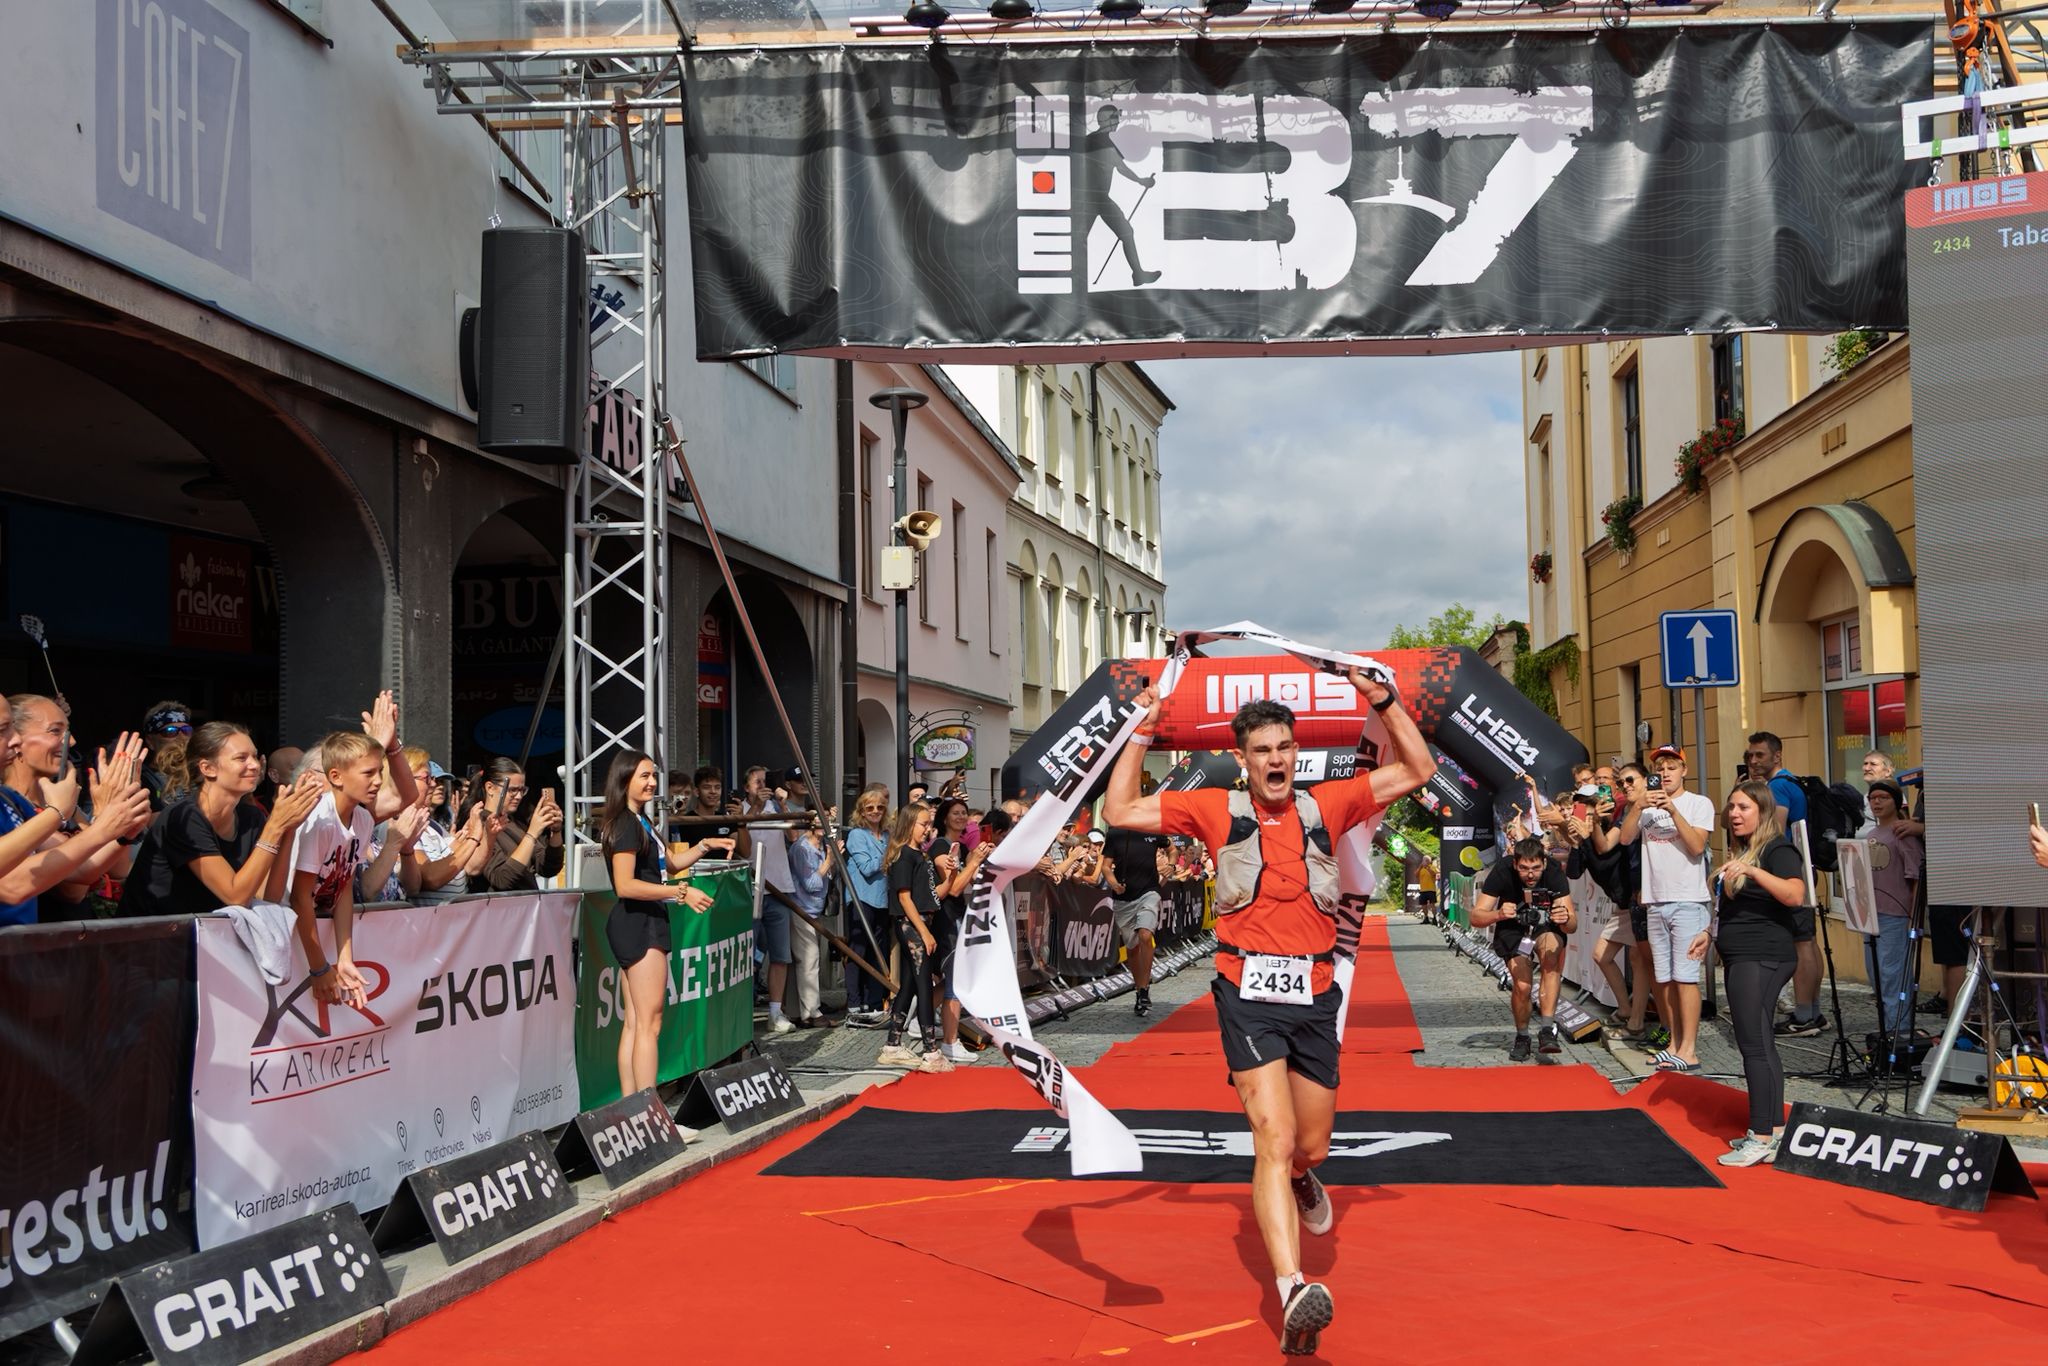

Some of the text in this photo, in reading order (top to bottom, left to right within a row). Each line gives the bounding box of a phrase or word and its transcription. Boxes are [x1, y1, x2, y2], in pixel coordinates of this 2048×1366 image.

[117, 0, 244, 251] CAFE 7
[1933, 223, 2048, 254] 2434 Taba
[176, 583, 245, 620] rieker
[1206, 671, 1358, 713] IMOS
[1460, 693, 1540, 767] LH24
[1248, 971, 1306, 994] 2434
[250, 1033, 390, 1097] KARIREAL
[714, 1069, 775, 1117] CRAFT
[592, 1107, 653, 1169] CRAFT
[1789, 1122, 1944, 1179] CRAFT
[234, 1166, 373, 1221] karireal.skoda-auto.cz
[432, 1160, 529, 1237] CRAFT
[154, 1245, 323, 1353] CRAFT
